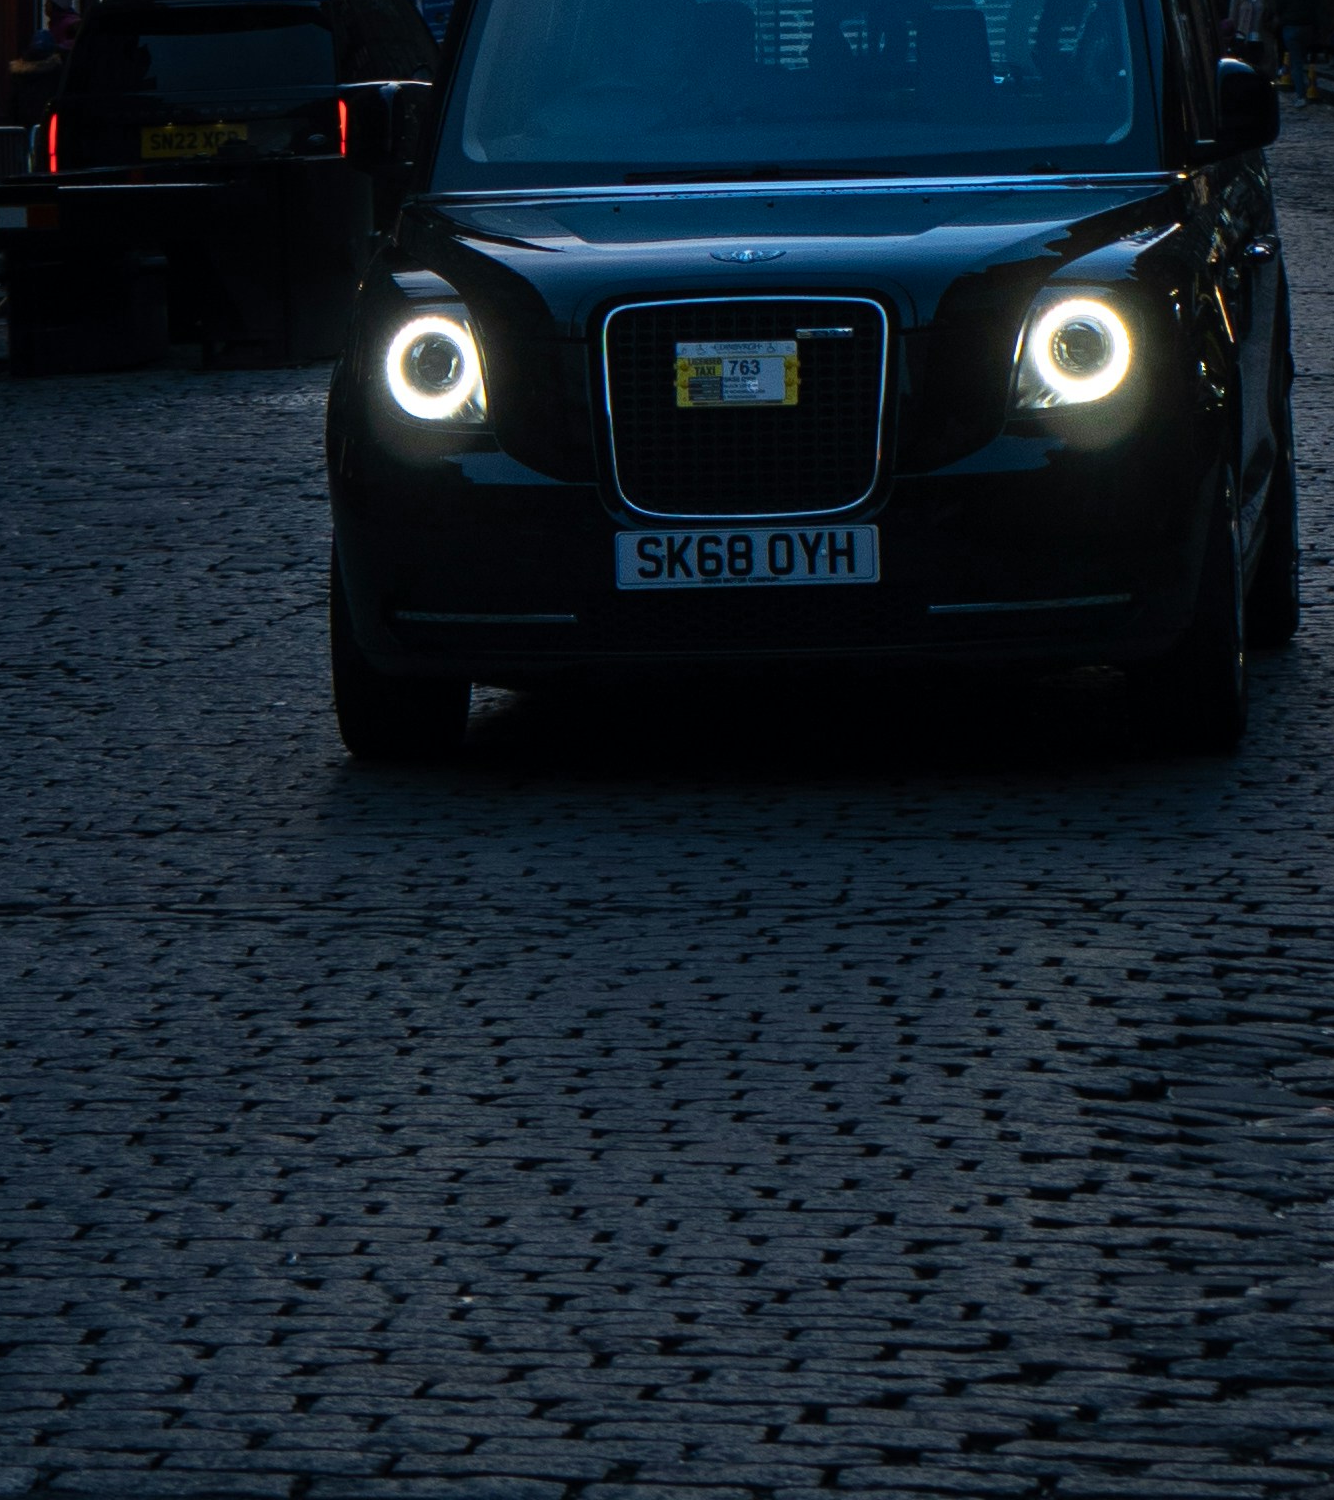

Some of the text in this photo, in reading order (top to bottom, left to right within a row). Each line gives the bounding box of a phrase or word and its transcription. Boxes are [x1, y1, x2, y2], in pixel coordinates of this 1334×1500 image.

[150, 131, 198, 150] SN22
[694, 366, 717, 376] TAXI
[728, 359, 761, 376] 763
[636, 531, 855, 579] SK68 OYH
